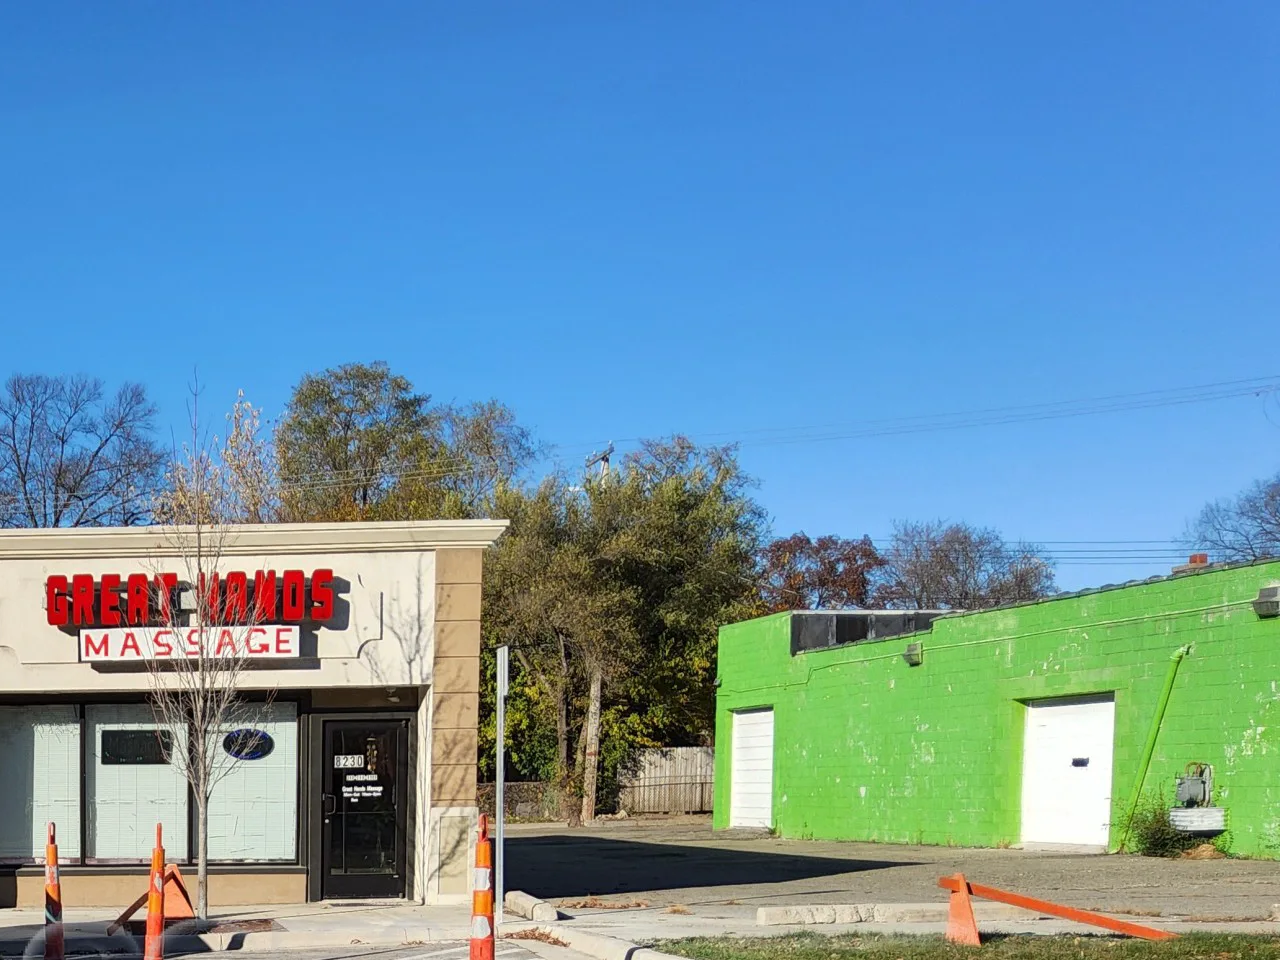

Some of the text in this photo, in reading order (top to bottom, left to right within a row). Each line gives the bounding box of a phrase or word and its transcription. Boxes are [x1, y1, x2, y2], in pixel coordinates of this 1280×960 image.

[47, 569, 333, 625] GREAT HANDS
[84, 627, 293, 658] MASSAGE
[335, 755, 364, 768] 8230
